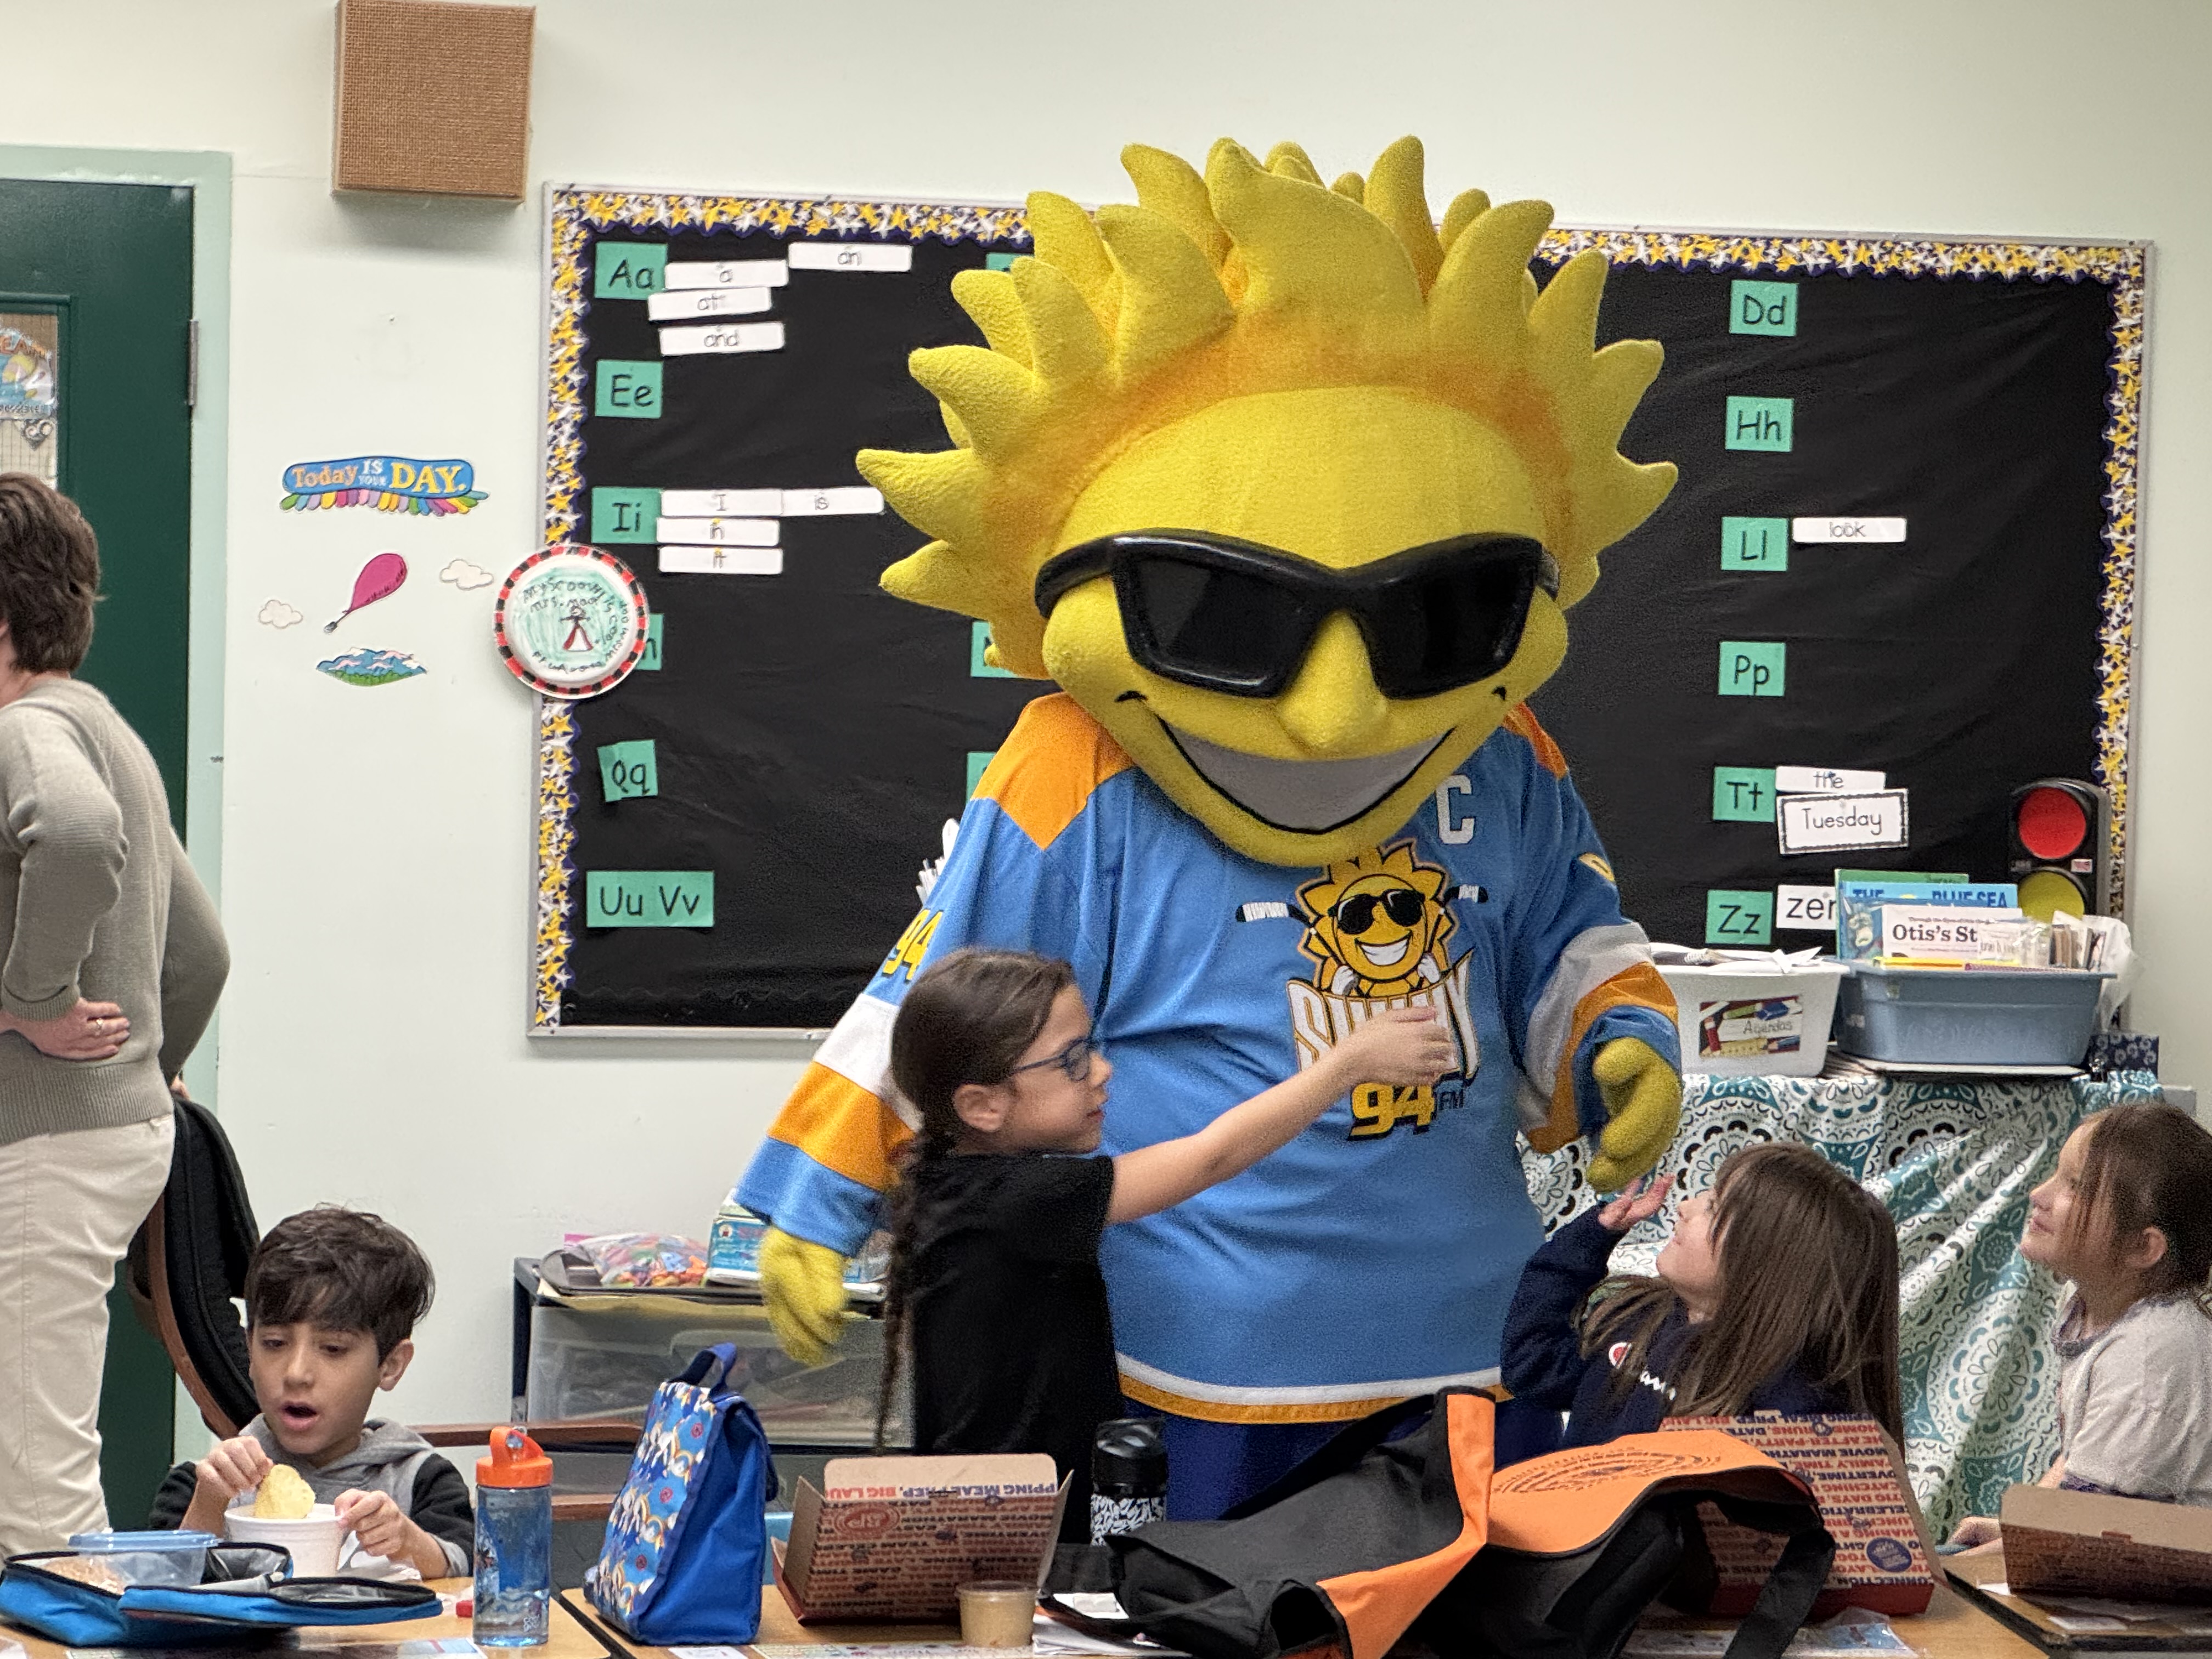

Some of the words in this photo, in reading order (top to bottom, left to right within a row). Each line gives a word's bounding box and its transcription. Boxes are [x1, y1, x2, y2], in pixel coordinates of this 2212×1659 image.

[837, 250, 862, 266] an
[608, 259, 656, 289] Aa
[719, 268, 733, 283] a
[697, 295, 725, 311] at
[1742, 295, 1787, 325] Dd
[704, 331, 739, 347] and
[611, 374, 654, 407] Ee
[1736, 410, 1781, 442] Hh
[292, 465, 359, 488] Today
[359, 475, 387, 487] YOUR
[362, 459, 383, 475] IS
[390, 462, 468, 494] DAY.
[612, 501, 641, 533] Ii
[715, 493, 727, 512] I
[814, 494, 830, 511] is
[709, 521, 725, 540] in
[1829, 521, 1867, 538] look
[1740, 529, 1767, 561] Ll
[713, 552, 727, 570] it
[1734, 654, 1770, 696] Pp
[611, 759, 650, 794] Qq
[1813, 771, 1844, 789] the
[1435, 774, 1475, 844] C
[1726, 781, 1764, 811] Tt
[1801, 806, 1882, 836] Tuesday
[600, 885, 643, 917] Uu
[659, 885, 700, 917] Vv
[1718, 904, 1762, 934] Zz
[882, 909, 944, 984] 94
[1348, 1082, 1437, 1139] 94
[825, 1487, 864, 1499] LAU
[1819, 1505, 1906, 1515] ELEBRATIO
